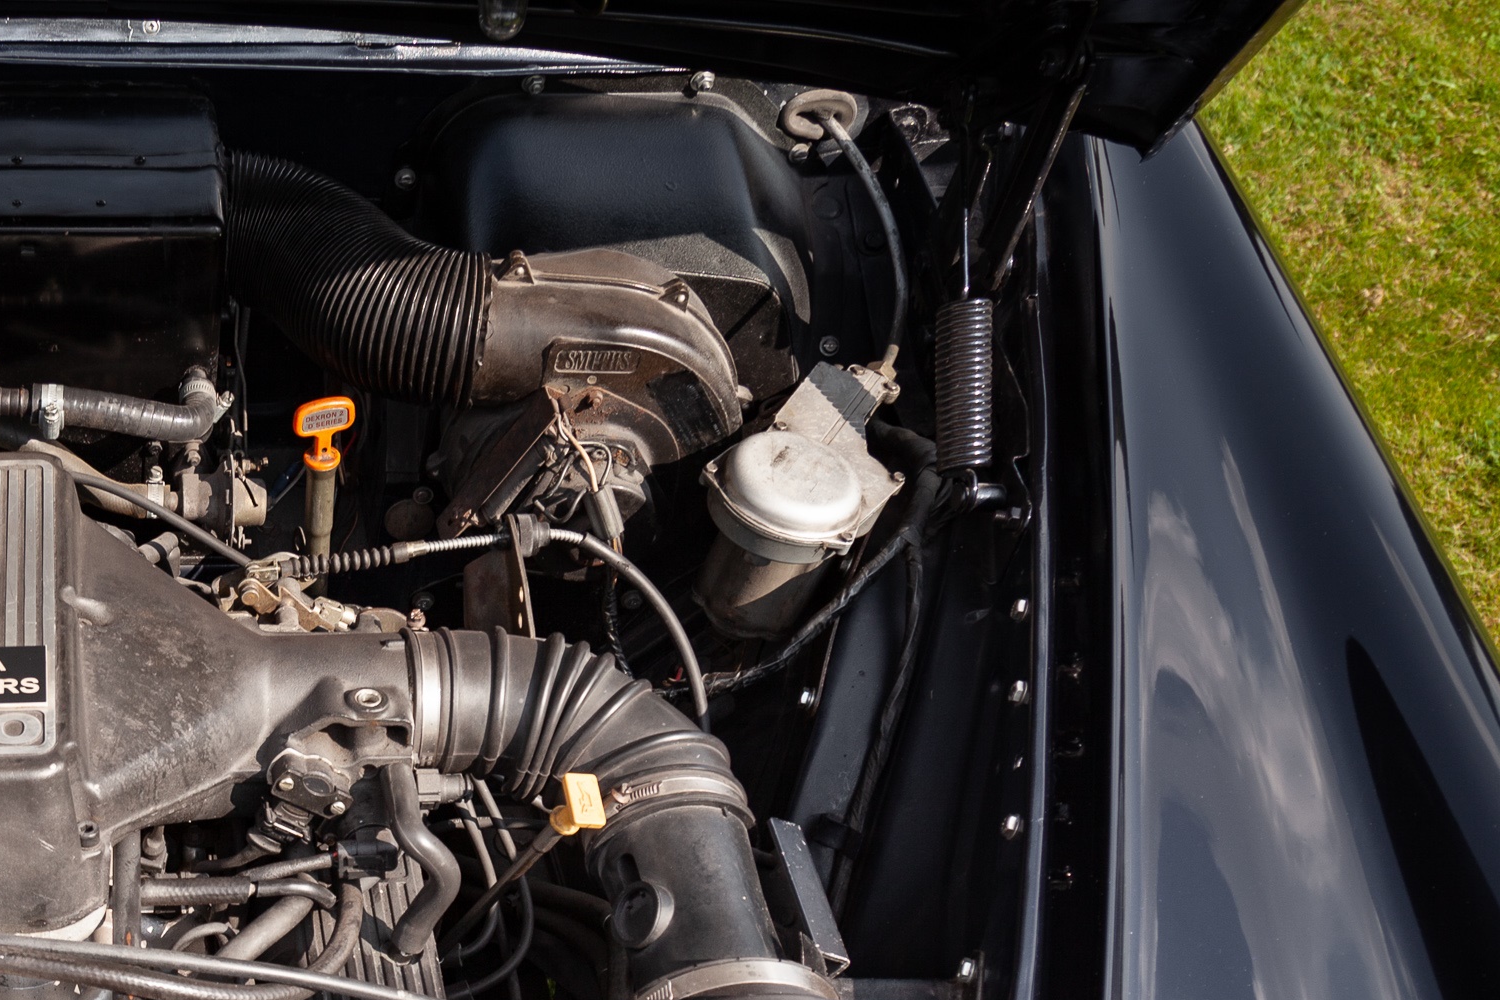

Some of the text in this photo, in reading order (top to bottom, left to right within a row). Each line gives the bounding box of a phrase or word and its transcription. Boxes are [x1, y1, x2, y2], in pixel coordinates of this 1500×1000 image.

[565, 349, 632, 371] SMITHS
[306, 412, 337, 422] DEXRON
[316, 418, 342, 428] SERIES
